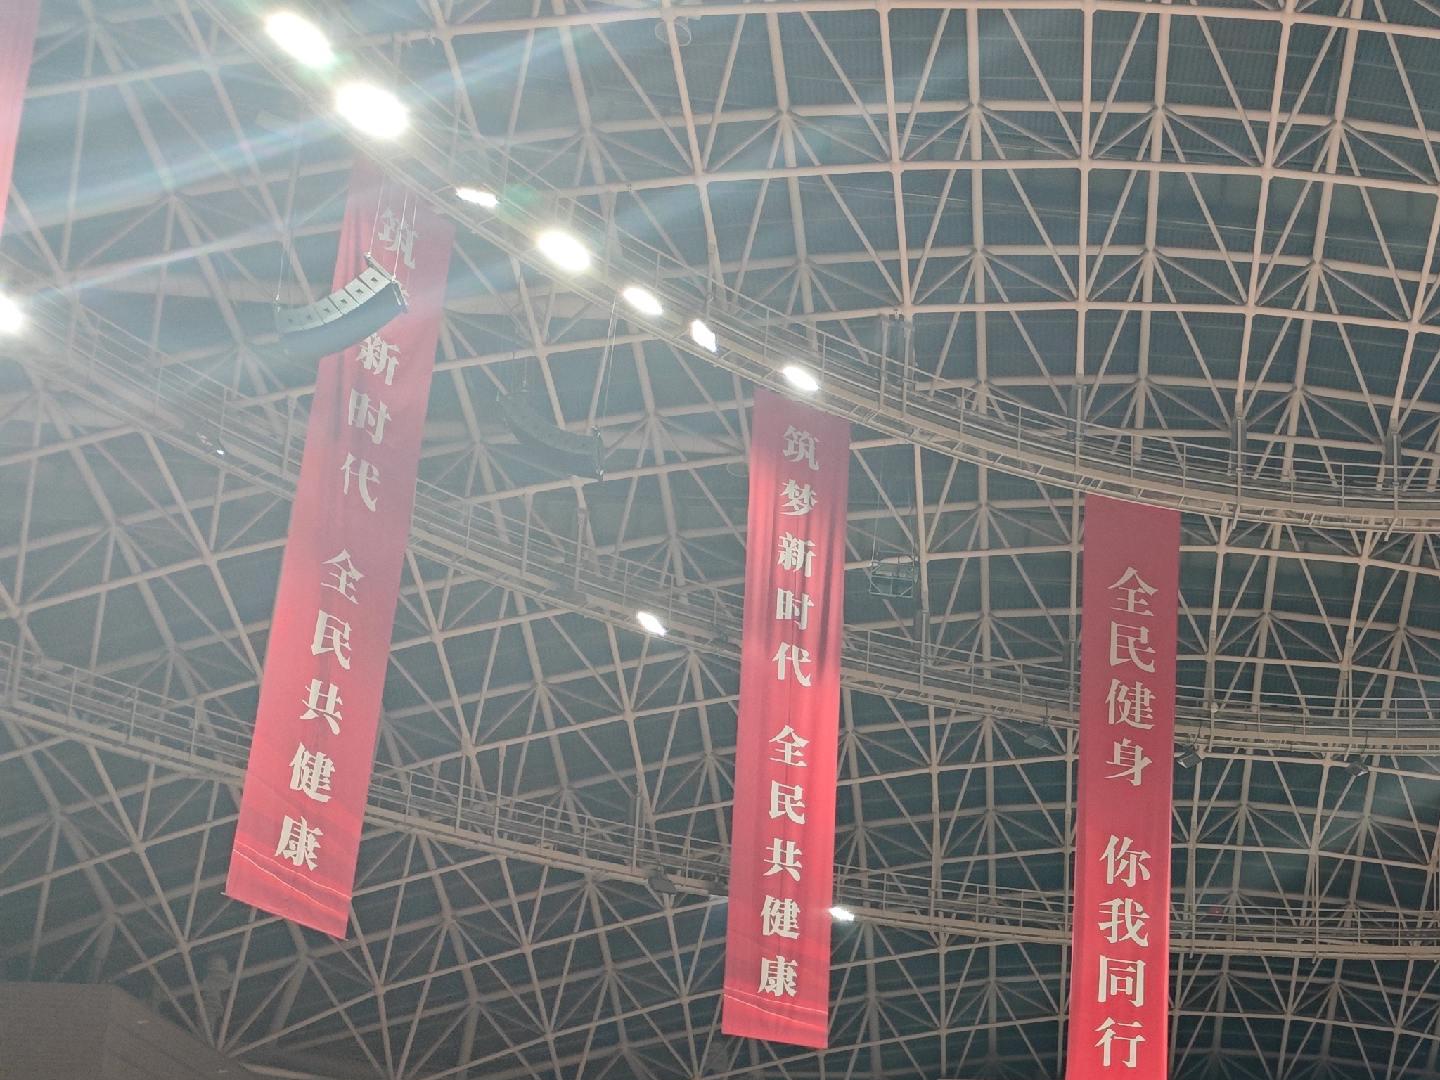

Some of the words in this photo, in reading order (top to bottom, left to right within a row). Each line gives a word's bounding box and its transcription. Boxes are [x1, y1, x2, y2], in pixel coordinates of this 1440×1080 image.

[339, 207, 419, 513] 筑新时代
[771, 424, 819, 688] 筑梦新时代
[1104, 566, 1159, 788] 全民健身
[274, 547, 361, 875] 全民共健康
[757, 724, 810, 999] 全民共健康
[1094, 834, 1152, 1069] 你我同行
